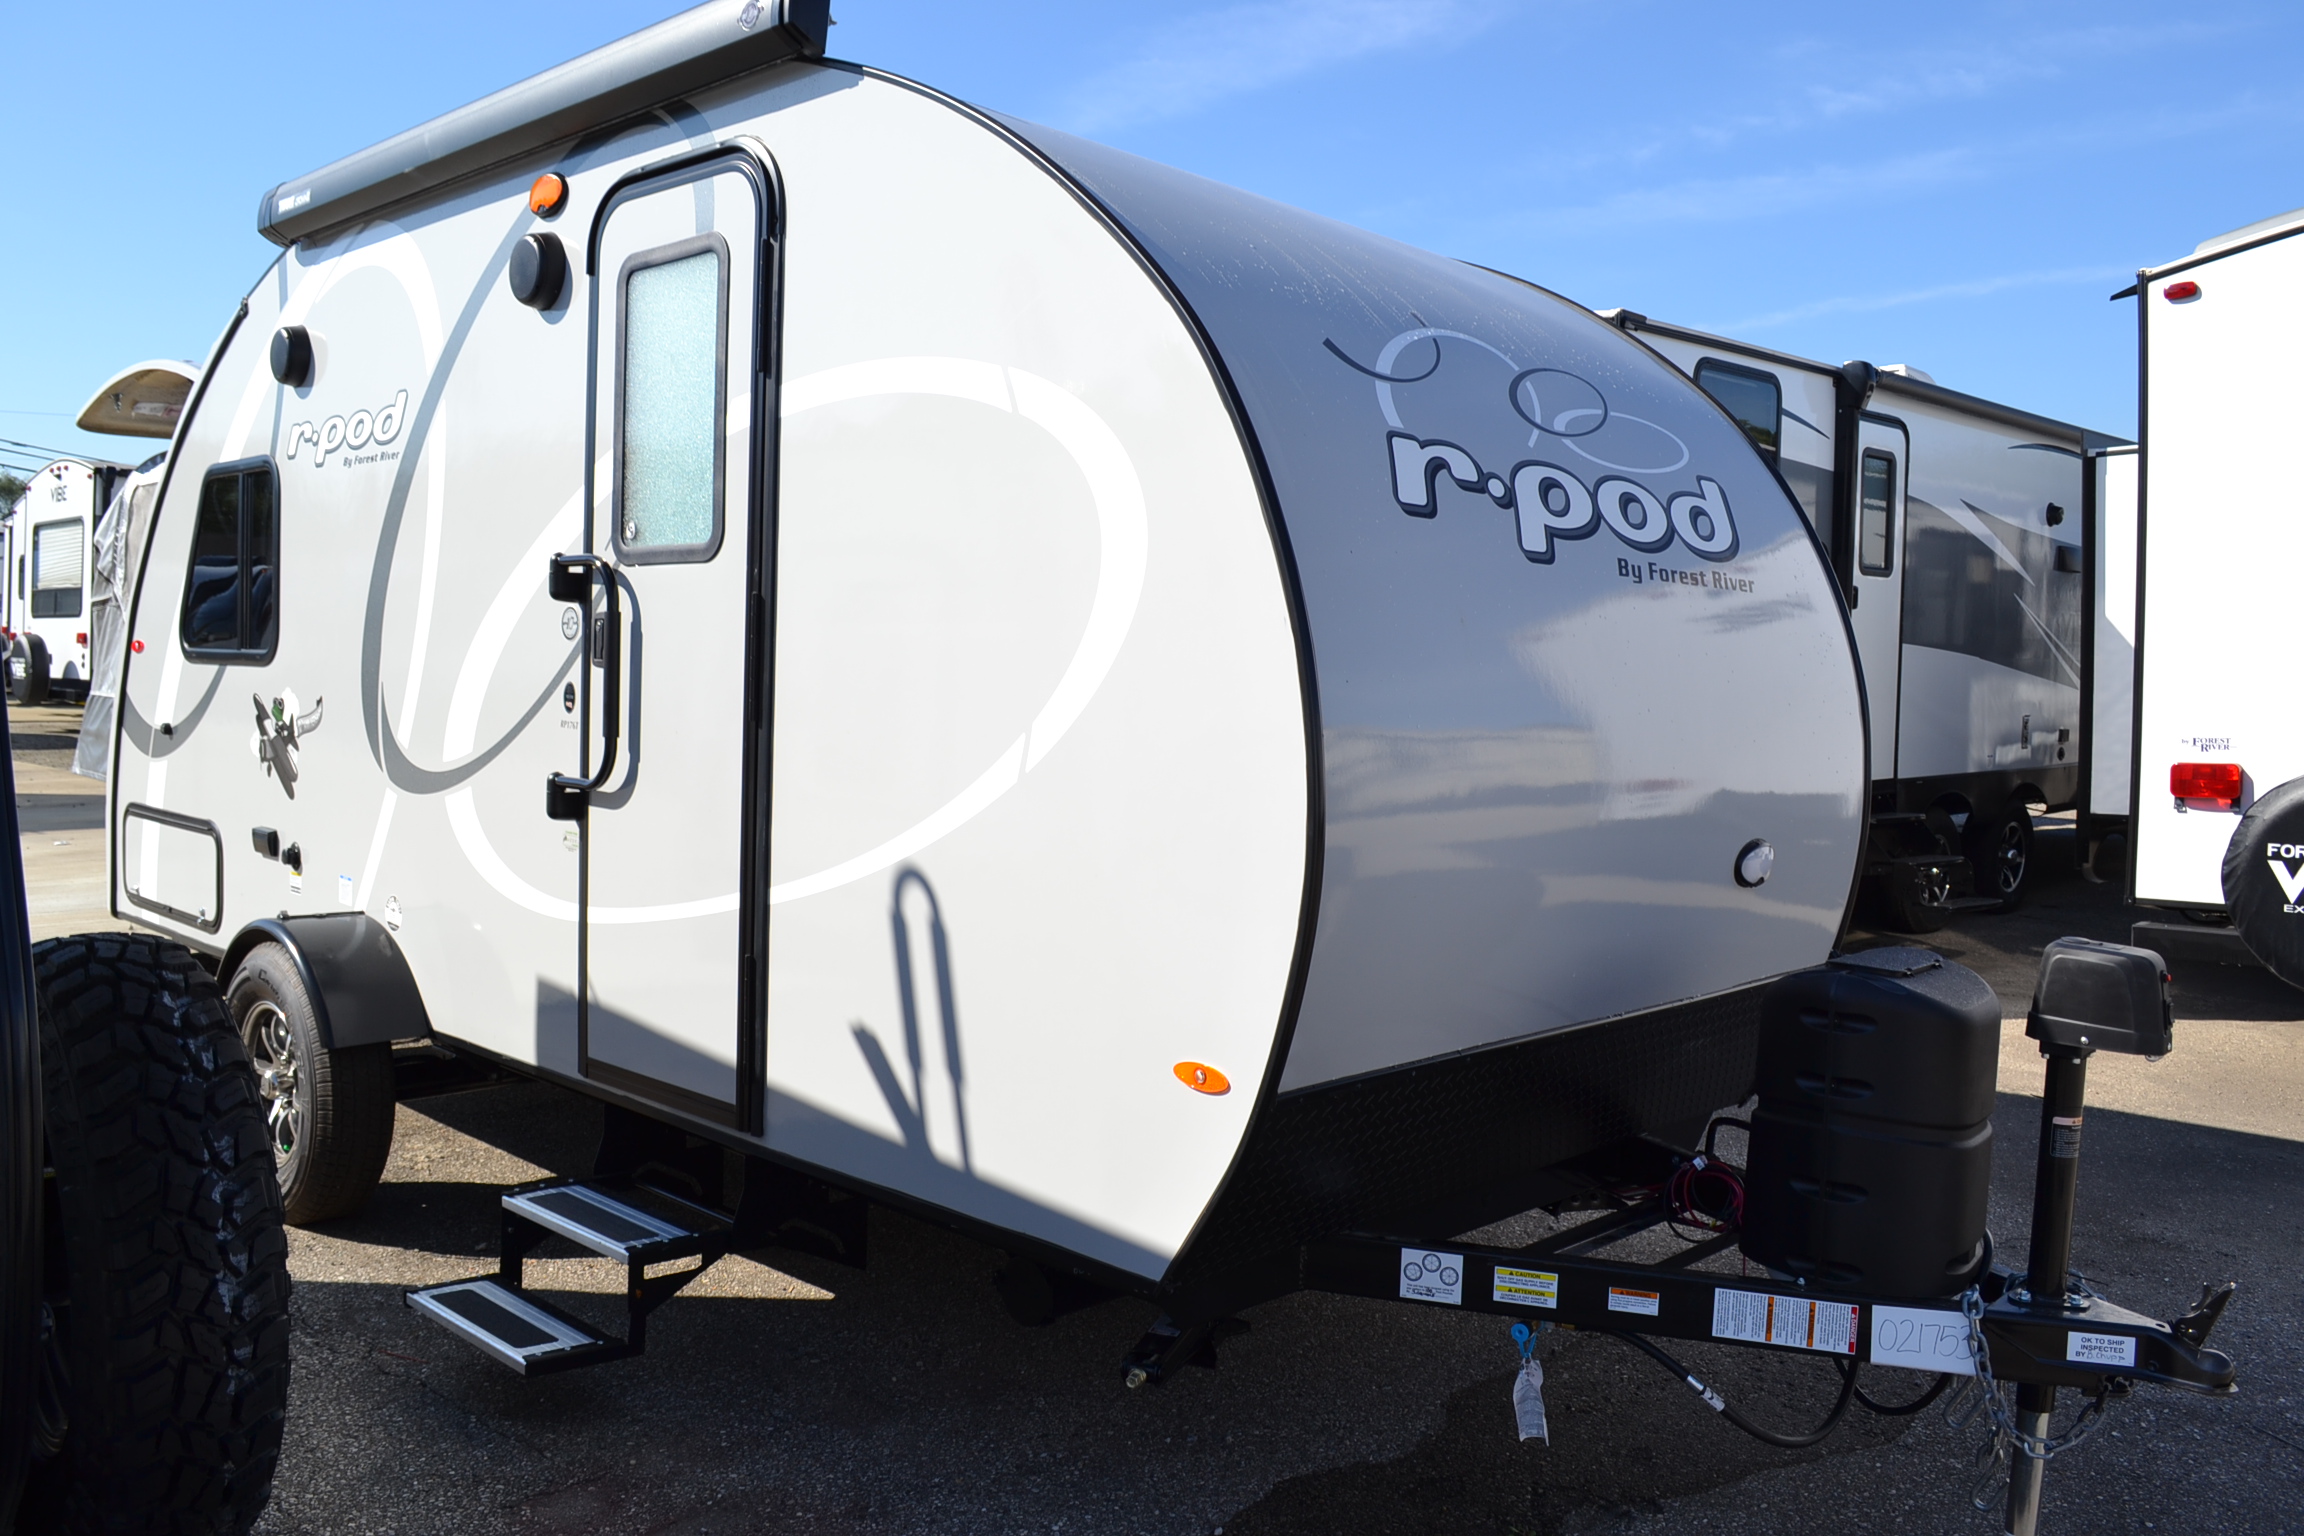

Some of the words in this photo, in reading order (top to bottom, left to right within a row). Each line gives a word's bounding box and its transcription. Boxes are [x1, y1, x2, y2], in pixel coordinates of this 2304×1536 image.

[343, 457, 353, 469] By
[354, 454, 378, 465] Forest
[379, 451, 400, 461] River
[1617, 557, 1643, 584] By
[1648, 562, 1708, 587] Forest
[1712, 570, 1755, 593] River
[2201, 743, 2230, 752] RIVER
[1515, 1271, 1541, 1279] CAUTION
[1514, 1288, 1546, 1297] ATTENTION
[1624, 1290, 1651, 1298] WARNING
[2080, 1344, 2124, 1354] INSPECTED
